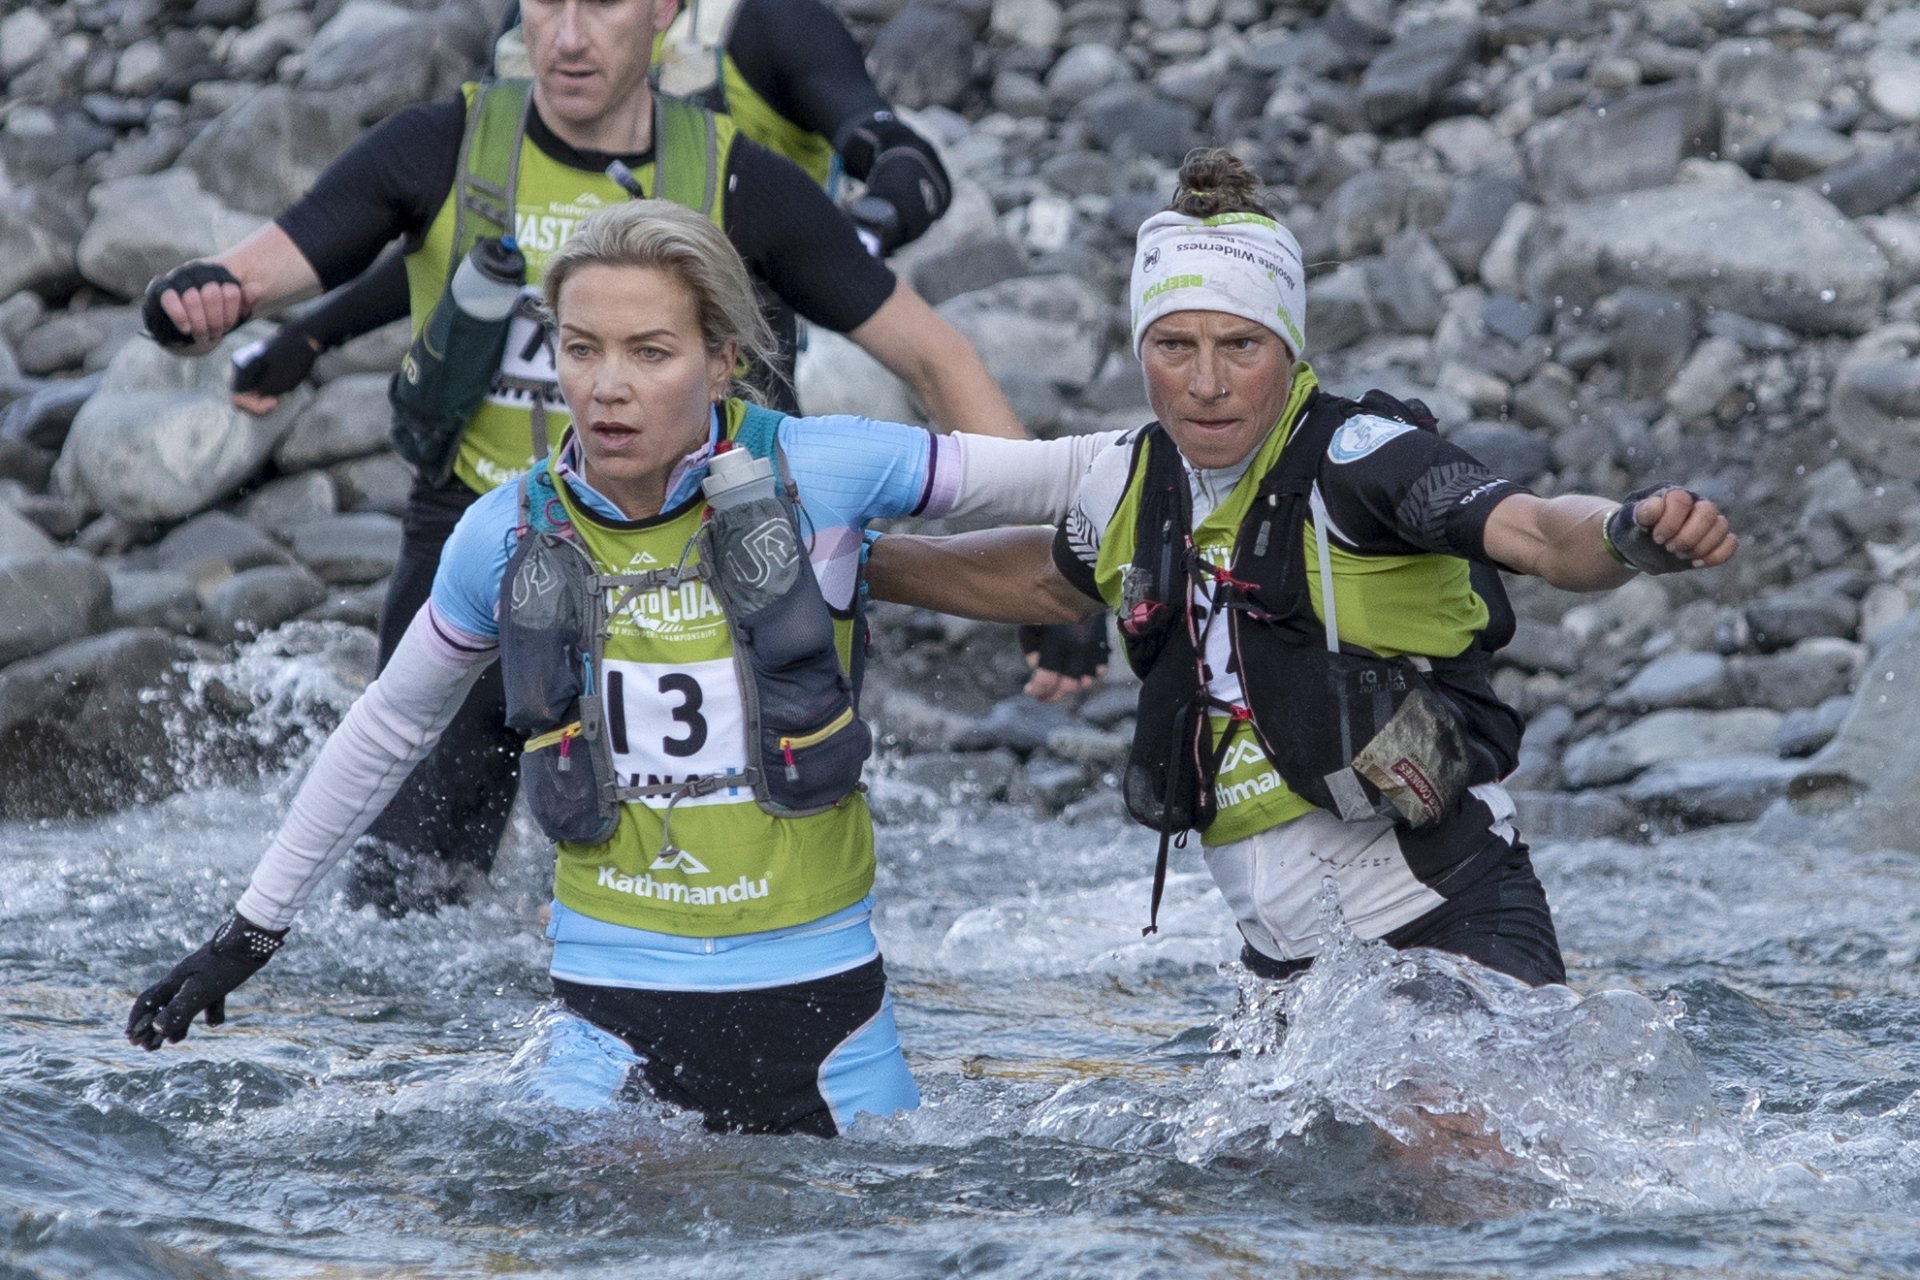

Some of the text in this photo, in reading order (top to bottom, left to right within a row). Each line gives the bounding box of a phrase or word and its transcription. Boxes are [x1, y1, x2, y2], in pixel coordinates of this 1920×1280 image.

[1176, 242, 1255, 264] Wilderness
[1257, 256, 1296, 291] Absolute
[660, 581, 724, 623] COA
[607, 670, 708, 758] 13
[597, 865, 769, 906] Kathmandu
